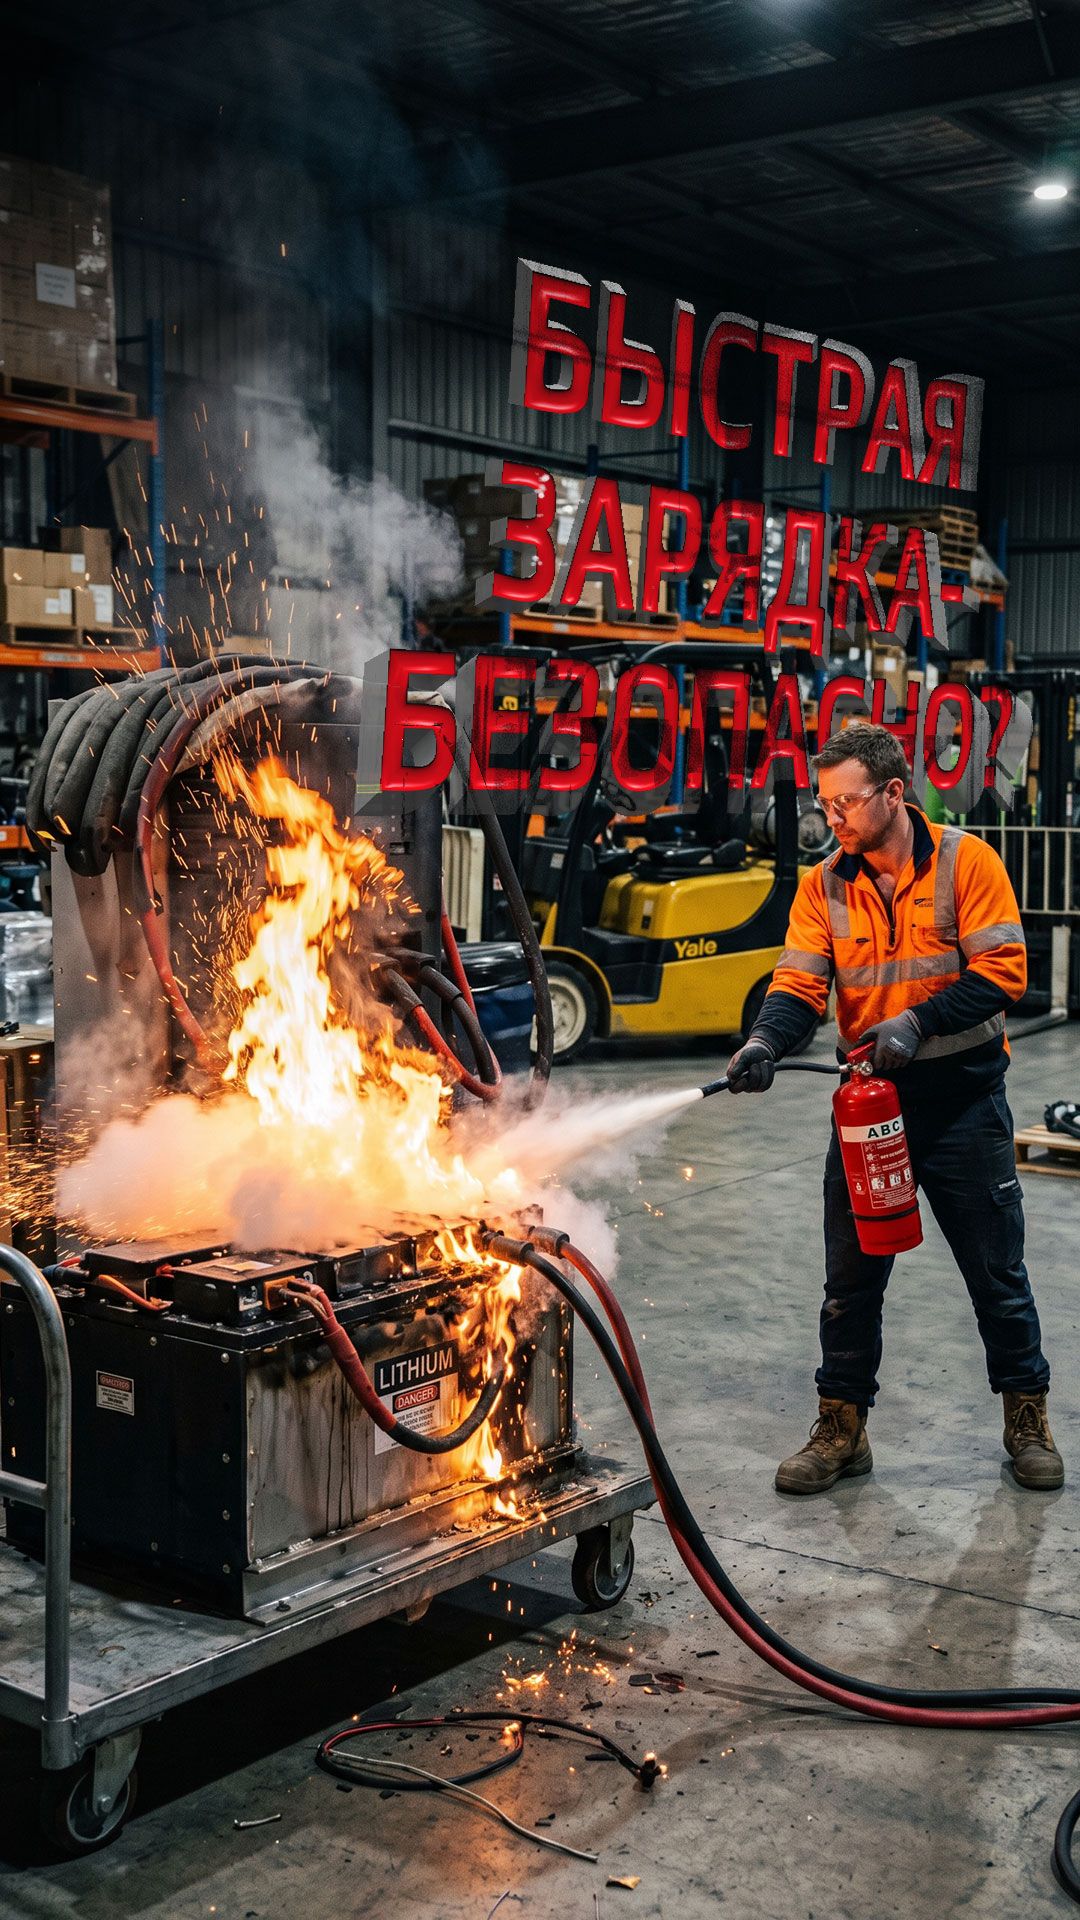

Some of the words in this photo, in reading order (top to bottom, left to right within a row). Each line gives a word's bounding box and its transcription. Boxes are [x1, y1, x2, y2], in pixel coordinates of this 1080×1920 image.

[674, 938, 718, 959] Yale
[867, 1120, 901, 1139] ABC
[380, 1347, 453, 1390] LITHIUM
[397, 1387, 435, 1409] DANGER
